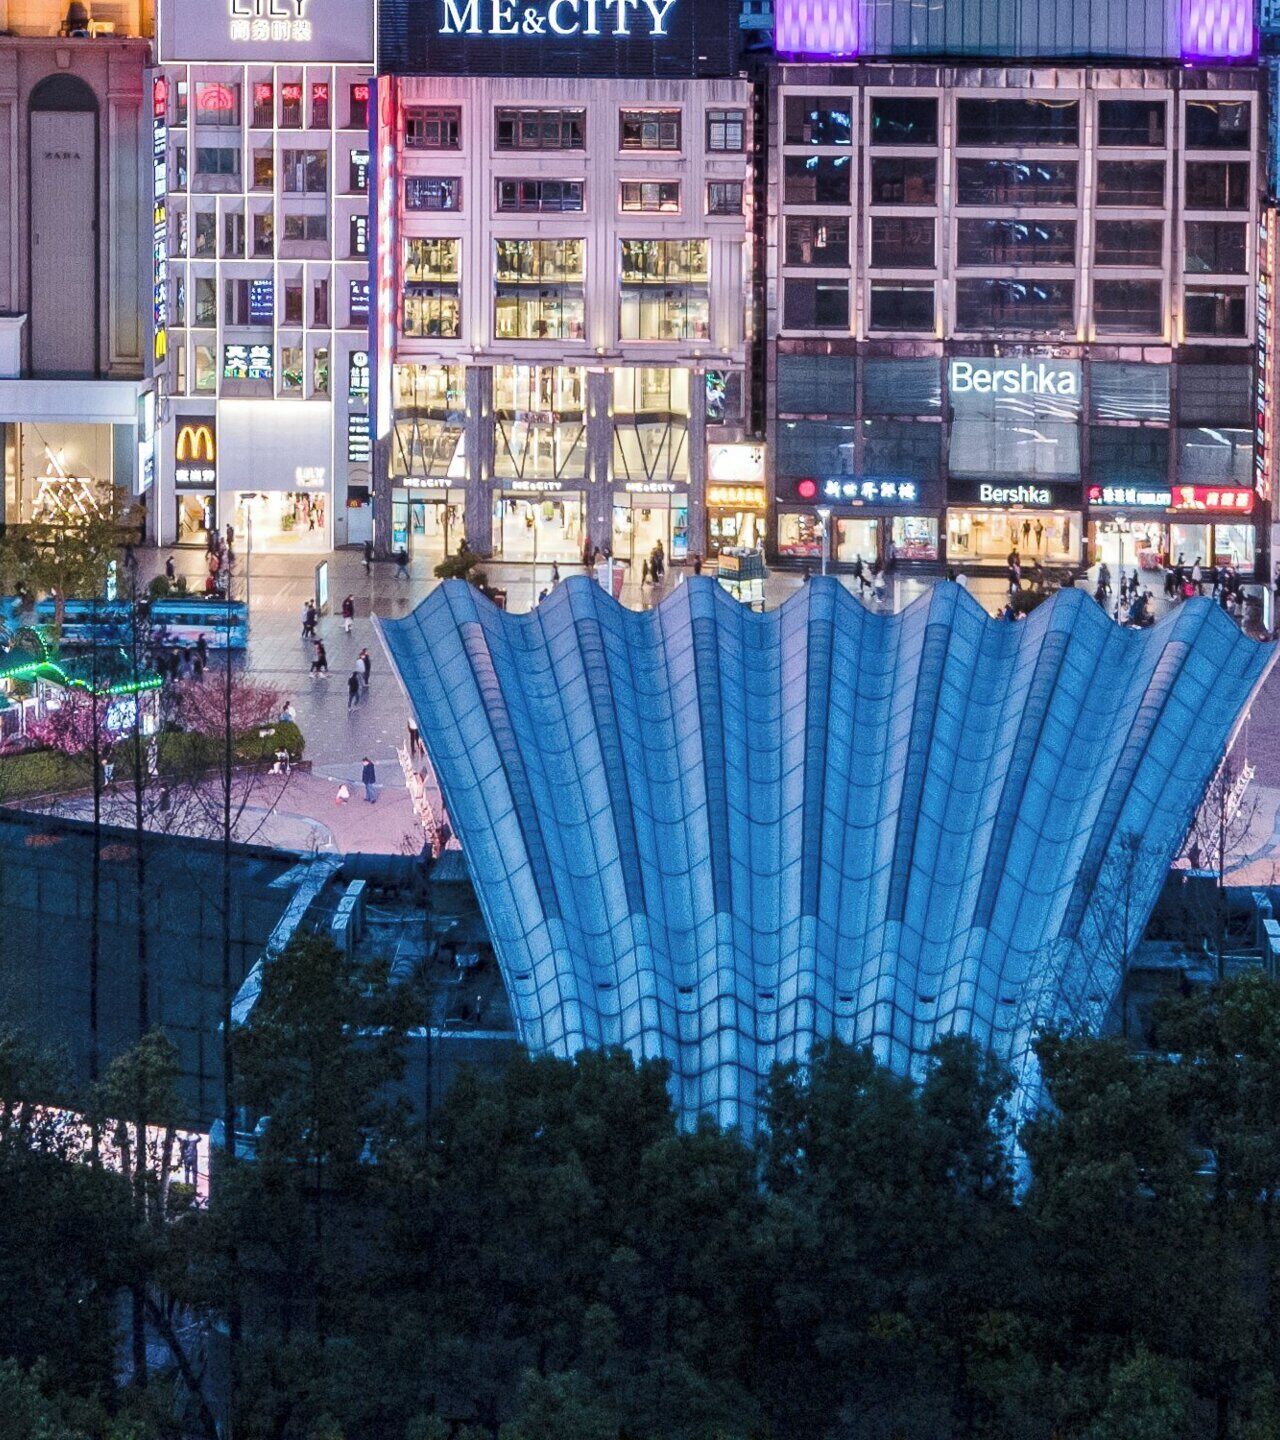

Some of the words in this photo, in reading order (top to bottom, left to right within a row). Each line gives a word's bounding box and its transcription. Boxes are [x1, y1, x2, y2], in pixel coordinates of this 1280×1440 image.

[230, 19, 312, 41] 商务时装
[951, 362, 1076, 395] Bershka
[979, 483, 1052, 504] Bershka
